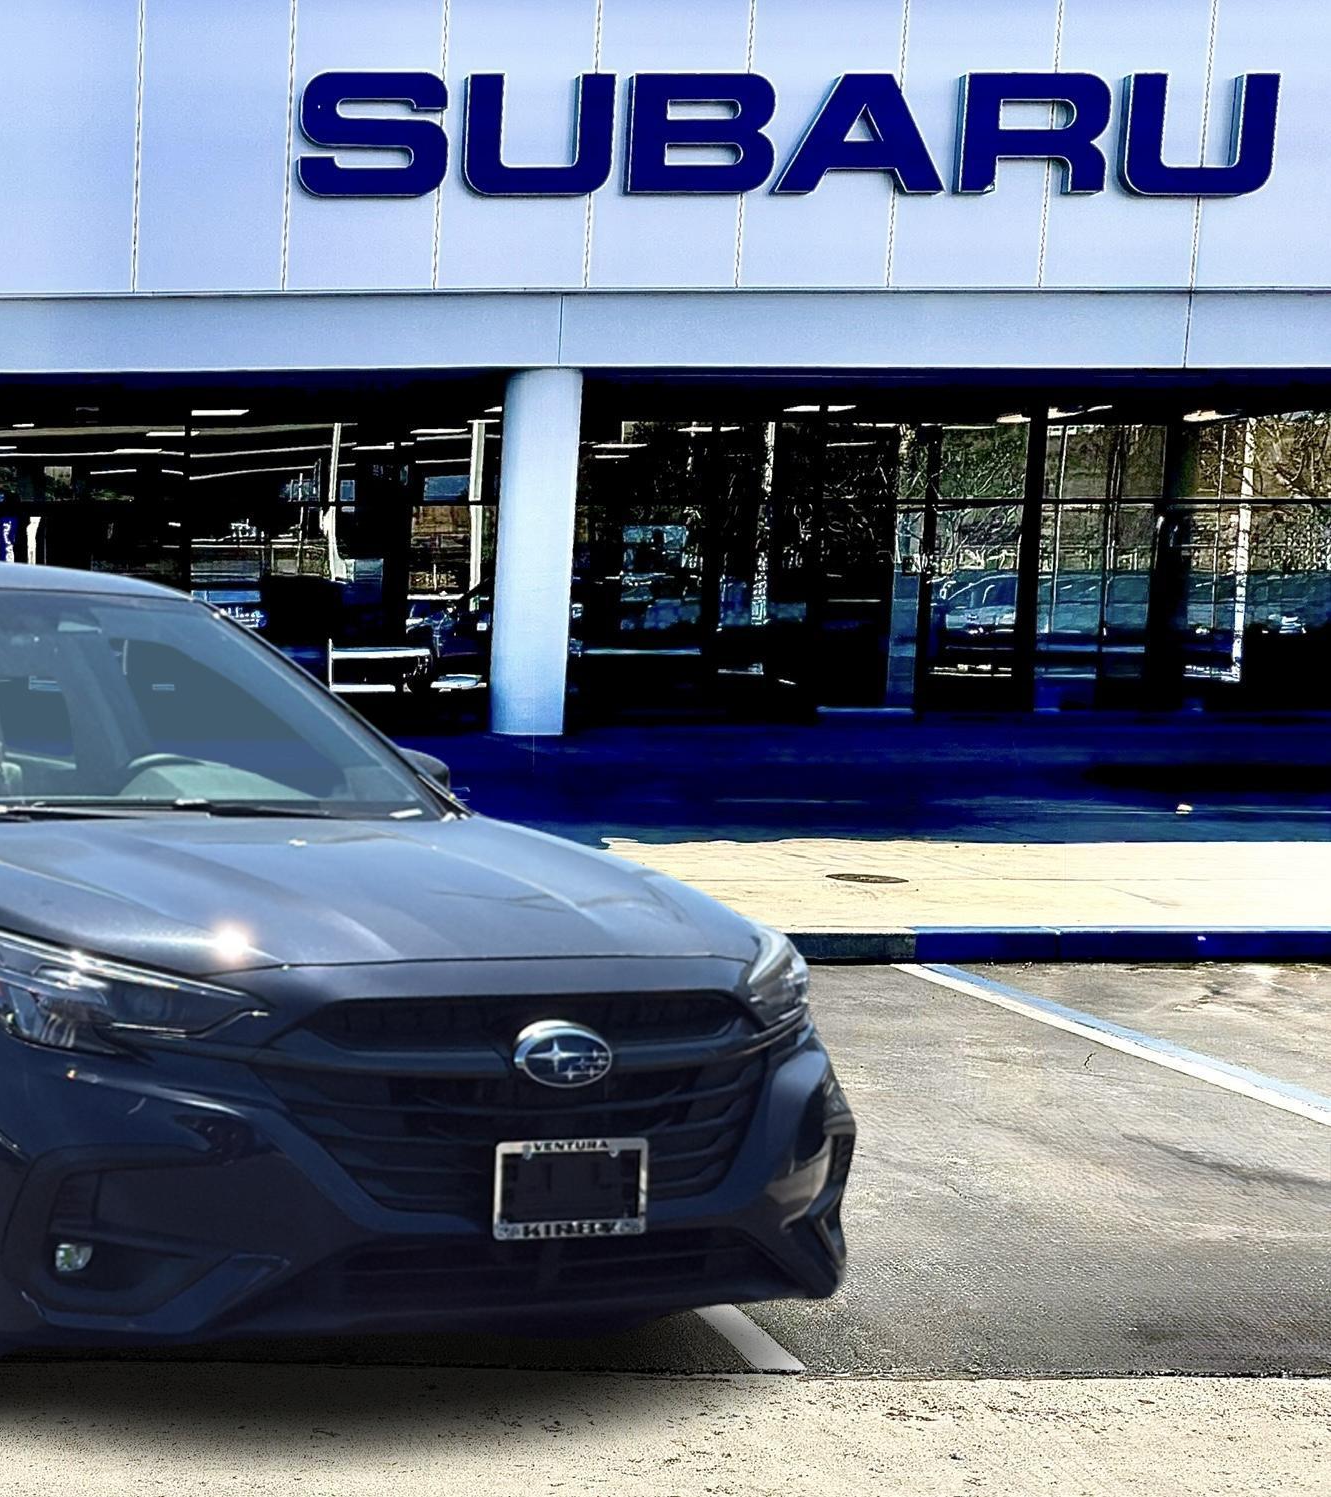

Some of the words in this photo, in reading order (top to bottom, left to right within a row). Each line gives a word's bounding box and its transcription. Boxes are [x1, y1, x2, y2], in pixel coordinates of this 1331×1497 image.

[296, 71, 1282, 197] SUBARU
[533, 1140, 609, 1151] VENTURA
[523, 1220, 618, 1237] KIRBY
